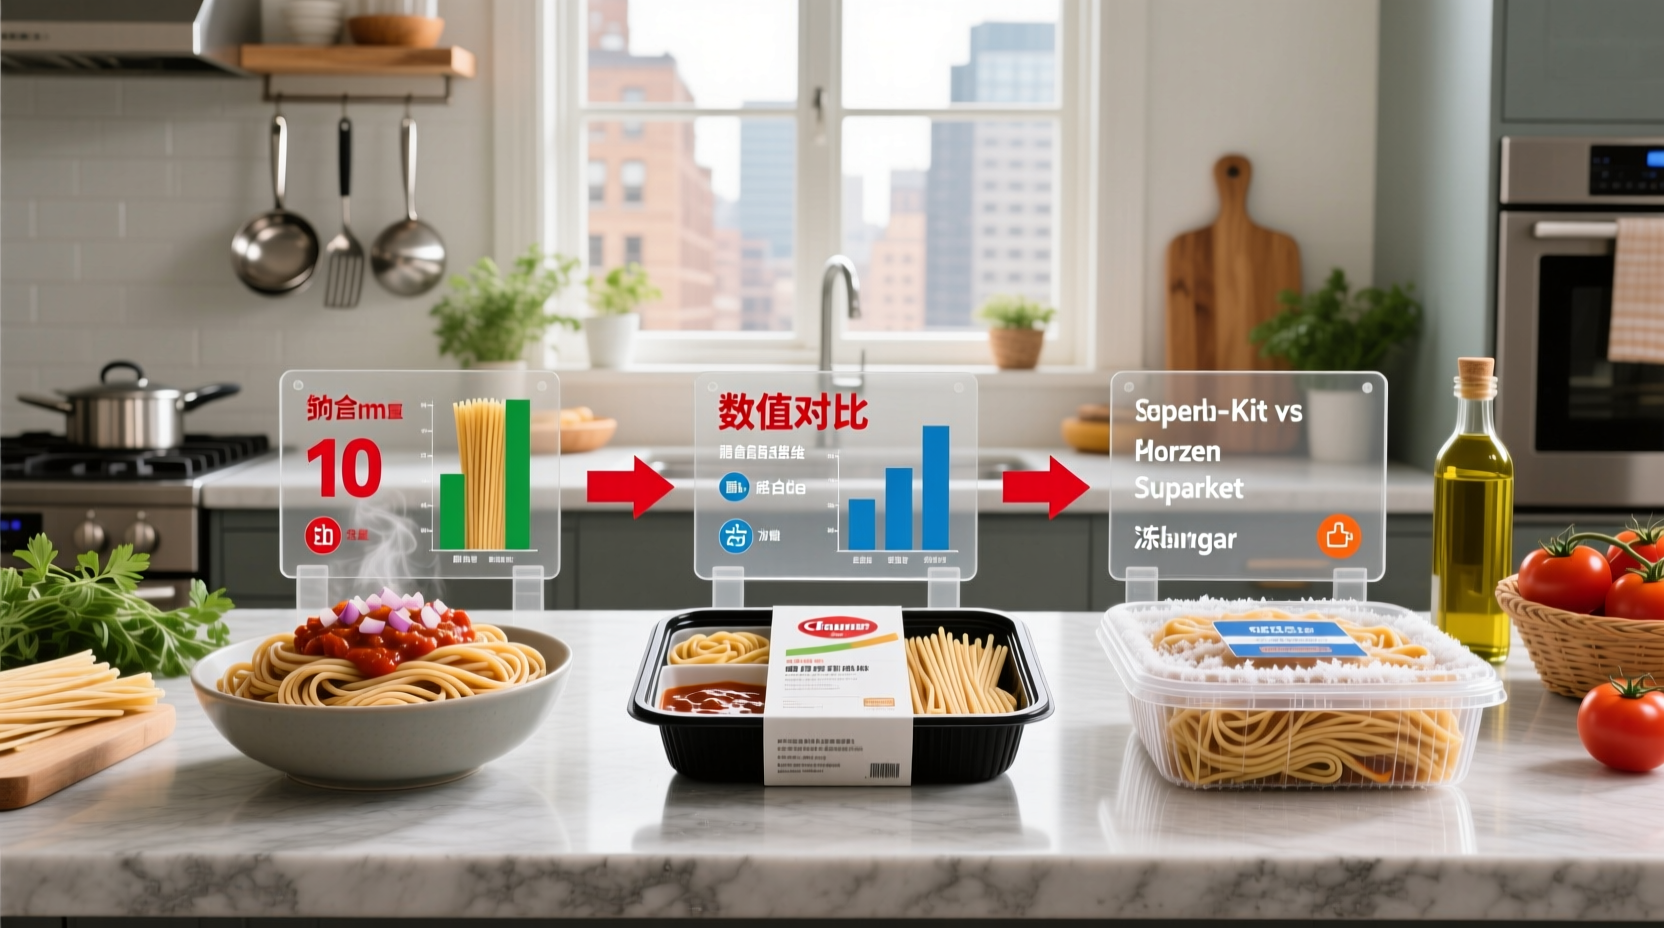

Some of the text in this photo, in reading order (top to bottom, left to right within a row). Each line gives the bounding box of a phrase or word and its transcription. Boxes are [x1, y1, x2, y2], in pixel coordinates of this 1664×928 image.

[718, 391, 869, 431] 数值对比
[1274, 404, 1303, 422] vs
[306, 437, 382, 498] 10
[1134, 475, 1245, 506] Suparket
